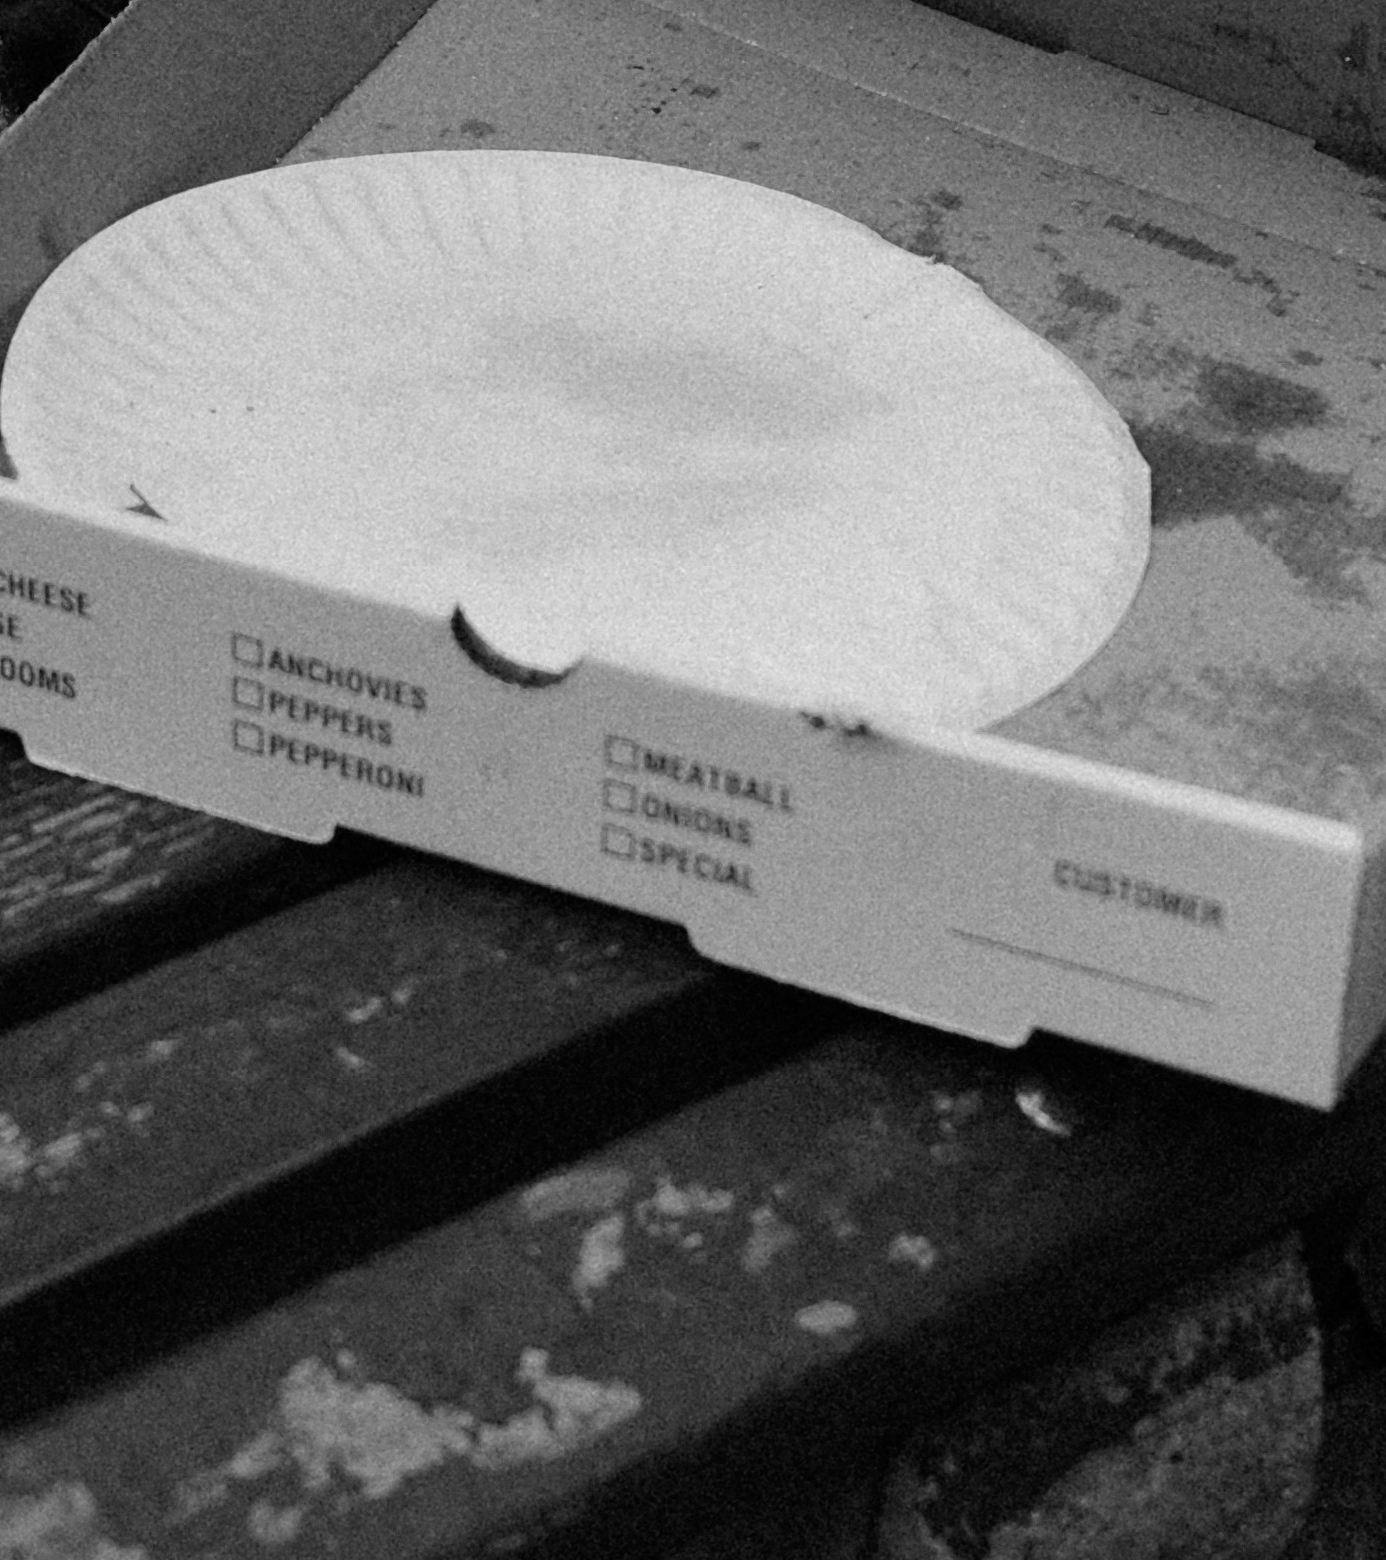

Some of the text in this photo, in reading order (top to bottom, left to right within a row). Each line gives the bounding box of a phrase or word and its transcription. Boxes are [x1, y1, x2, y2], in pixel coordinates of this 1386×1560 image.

[269, 649, 427, 711] ANCHOVIES
[268, 689, 393, 746] PEPPERS
[268, 733, 424, 798] PEPPERONI
[641, 793, 753, 847] ONIONS
[640, 837, 754, 893] SPECIAL
[1053, 859, 1224, 928] CUSTOMER
